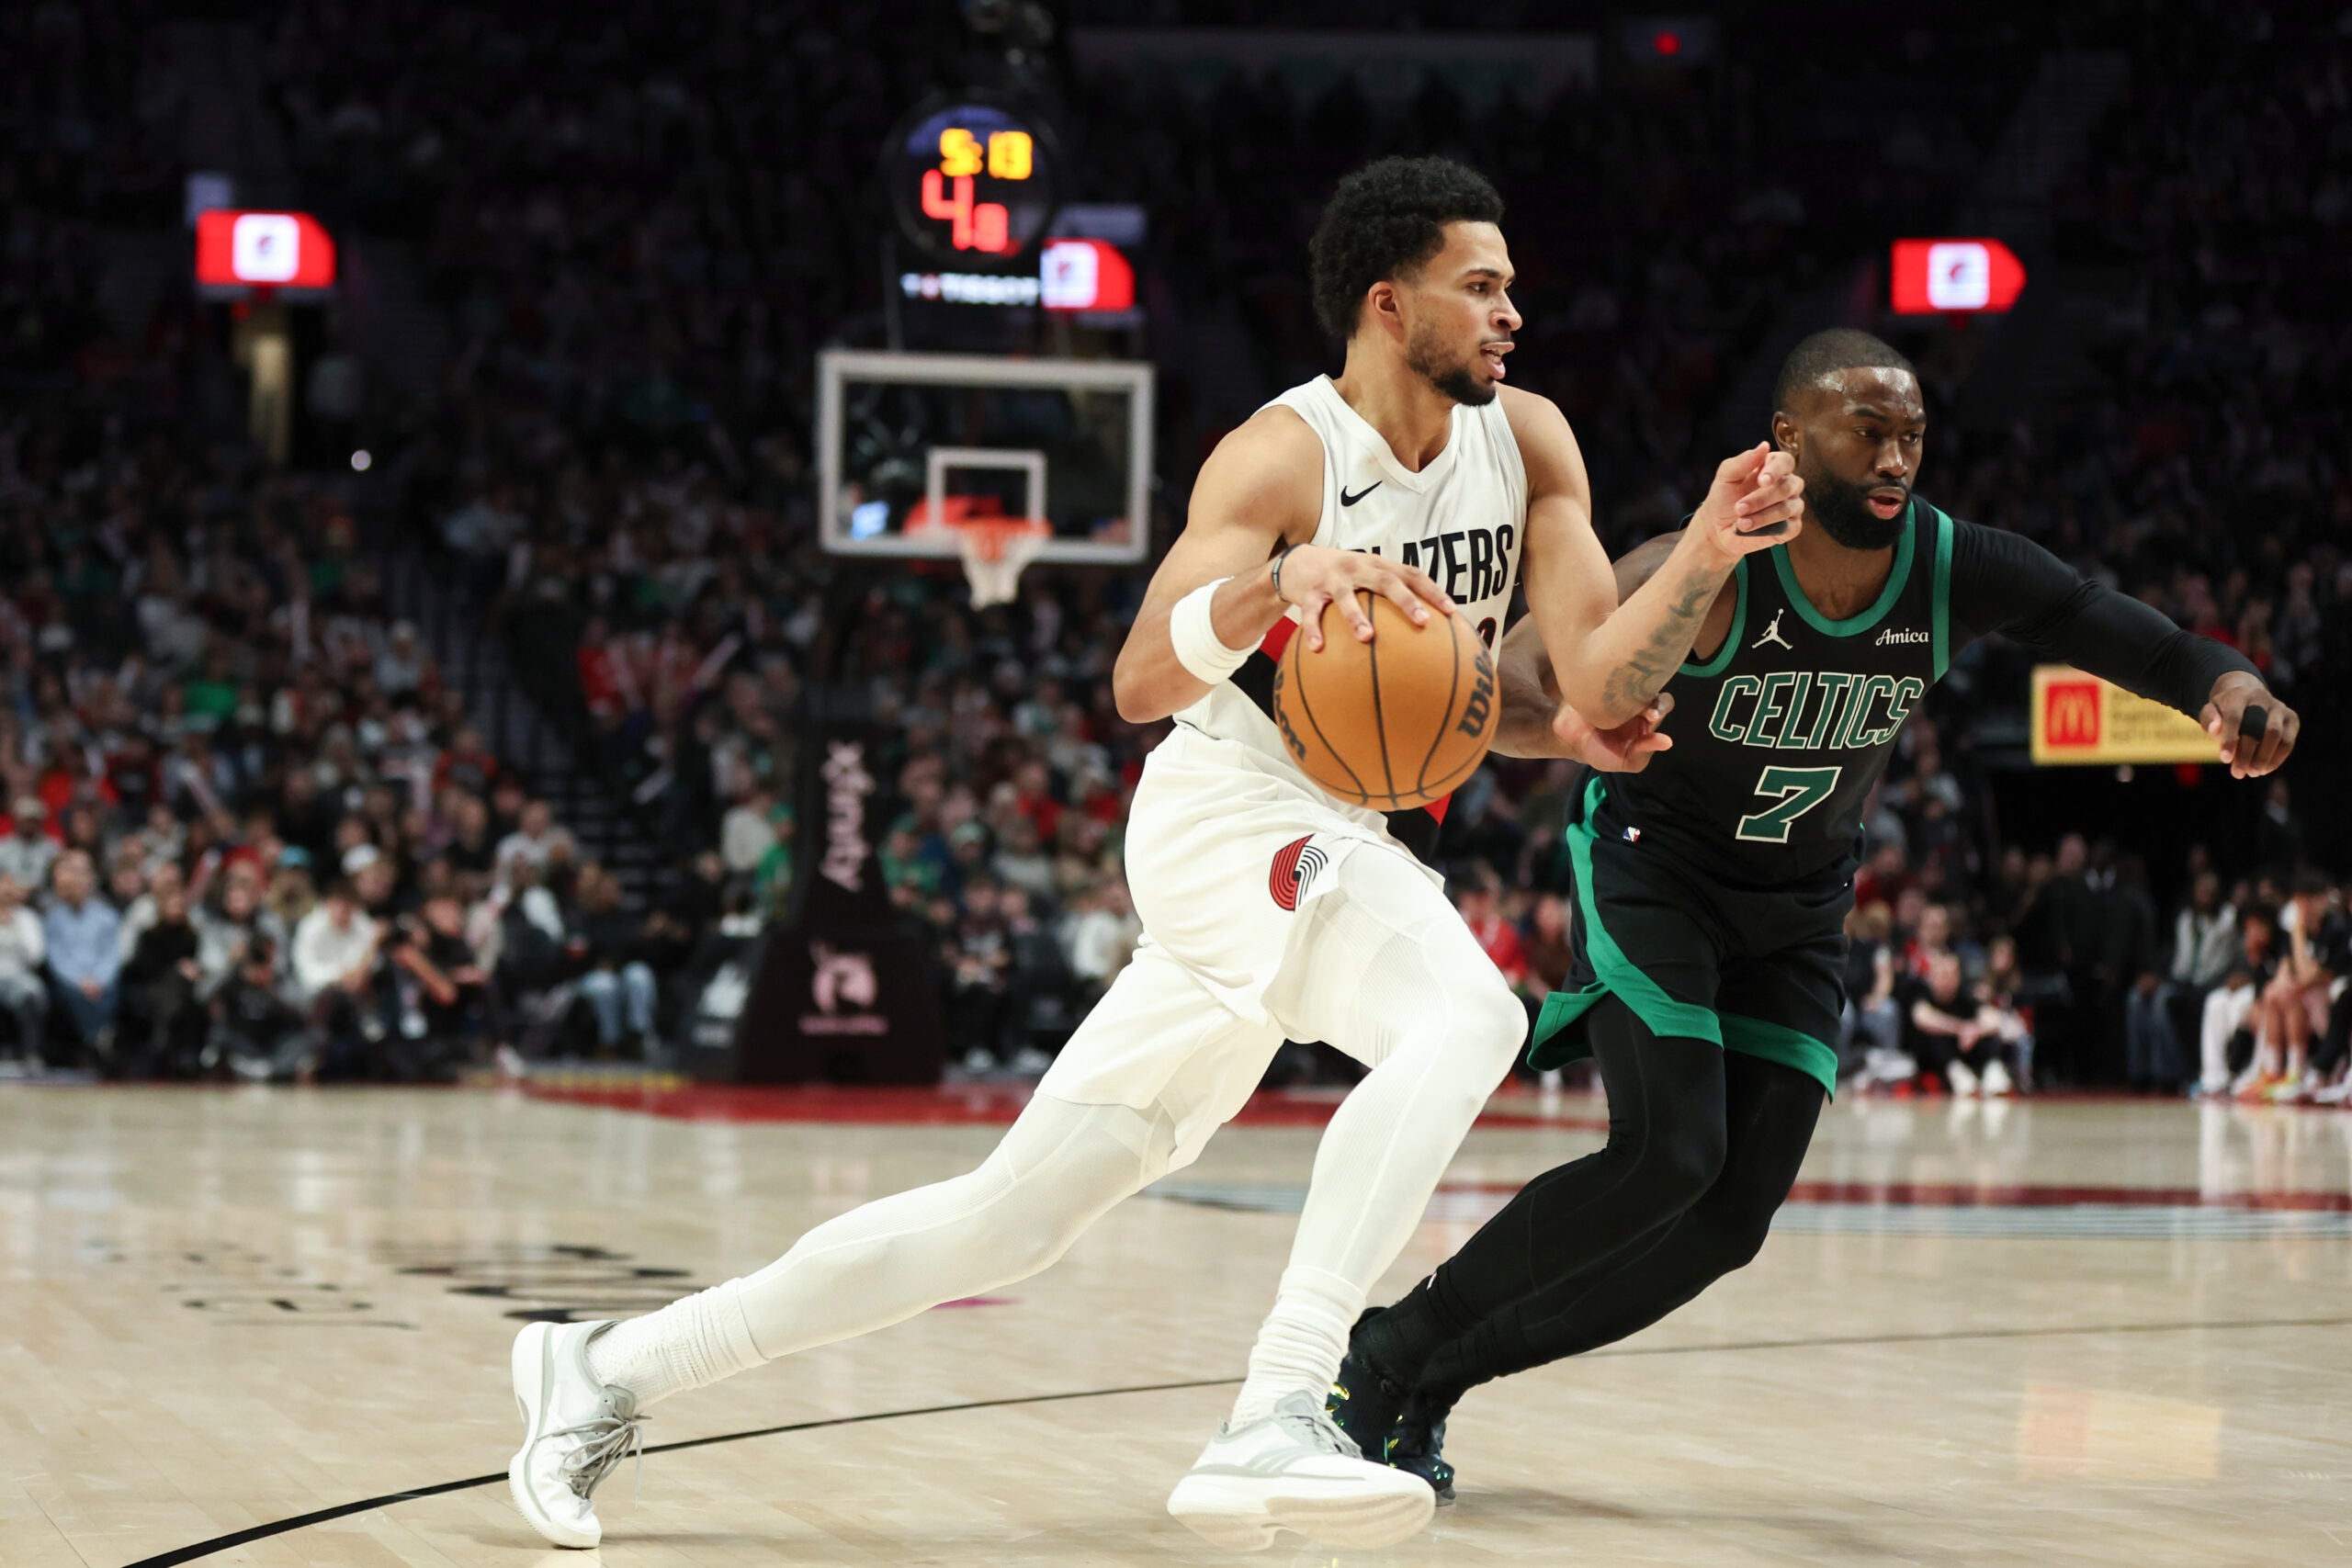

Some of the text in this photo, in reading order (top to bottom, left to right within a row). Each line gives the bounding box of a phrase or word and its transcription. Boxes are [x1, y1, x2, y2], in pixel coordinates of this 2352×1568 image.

[1875, 627, 1929, 646] Amica
[1709, 671, 1925, 750] CELTICS
[1735, 765, 1843, 843] 7
